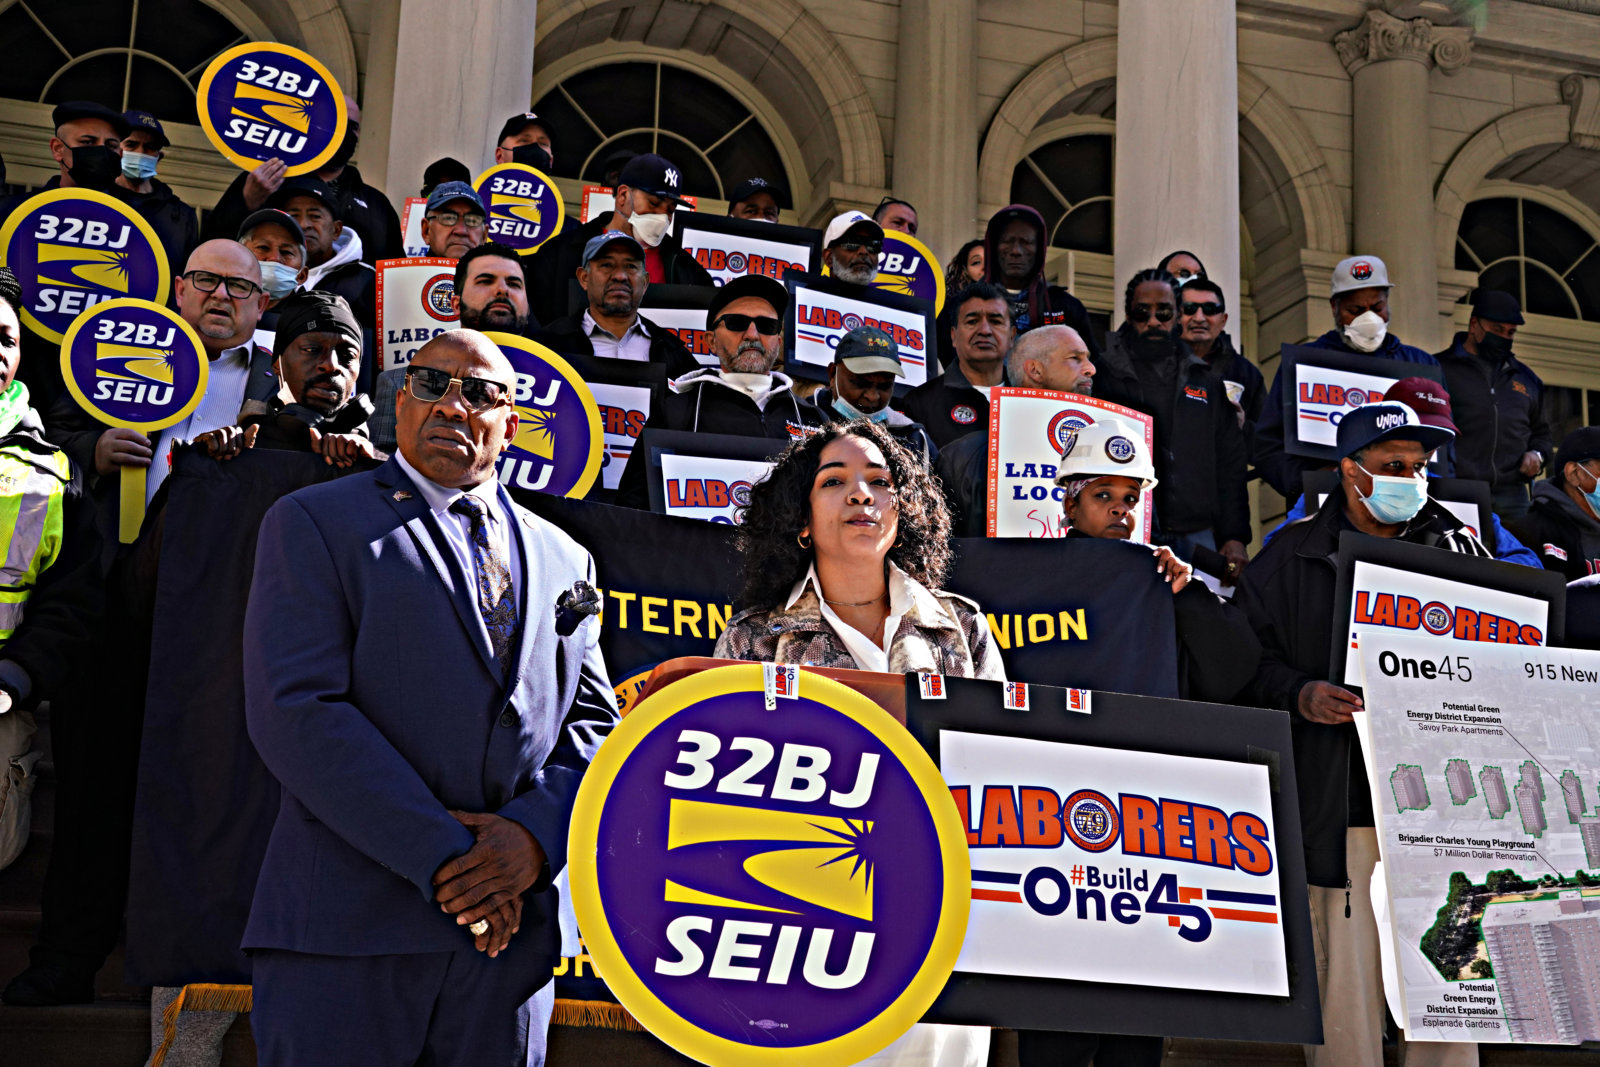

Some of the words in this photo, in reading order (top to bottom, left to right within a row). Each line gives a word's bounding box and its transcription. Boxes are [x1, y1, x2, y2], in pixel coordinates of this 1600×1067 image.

[235, 60, 320, 98] 32BJ
[224, 118, 308, 154] SEIU
[490, 177, 545, 198] 32BJ
[34, 214, 131, 249] 32BJ
[488, 219, 541, 239] SEIU
[34, 288, 118, 315] SEI
[94, 319, 176, 348] 32BJ
[93, 380, 175, 406] SEIU
[1376, 412, 1404, 429] UNION
[1111, 443, 1131, 456] 79
[496, 455, 555, 490] IU
[597, 588, 732, 639] TERN
[1354, 590, 1543, 647] LABORERS
[1525, 662, 1557, 680] 915
[1561, 665, 1599, 684] New
[1407, 710, 1433, 720] Energy
[1435, 712, 1462, 721] District
[1463, 714, 1502, 724] Expansion
[1443, 702, 1476, 711] Potential
[1478, 704, 1500, 713] Green
[1418, 723, 1440, 733] Savoy
[1442, 725, 1459, 733] Park
[1460, 726, 1503, 736] Apartments
[664, 729, 881, 809] 32BJ
[949, 784, 1274, 877] LABORERS
[1076, 809, 1108, 834] 79
[1398, 834, 1434, 844] Brigadier
[1435, 836, 1465, 845] Charles
[1466, 838, 1491, 848] Young
[1492, 839, 1535, 849] Playground
[1433, 848, 1443, 857] $7
[1445, 849, 1470, 858] Million
[1472, 851, 1493, 859] Dollar
[1496, 852, 1537, 861] Renovation
[1070, 864, 1149, 892] #Build
[1023, 866, 1212, 943] One45
[654, 915, 876, 990] SEIU
[1443, 994, 1467, 1003] Green
[1469, 995, 1496, 1005] Energy
[1459, 983, 1495, 992] Potential
[1427, 1005, 1456, 1014] District
[1457, 1006, 1498, 1016] Expansion
[1422, 1018, 1463, 1028] Esplanade
[1465, 1020, 1500, 1029] Gardents
